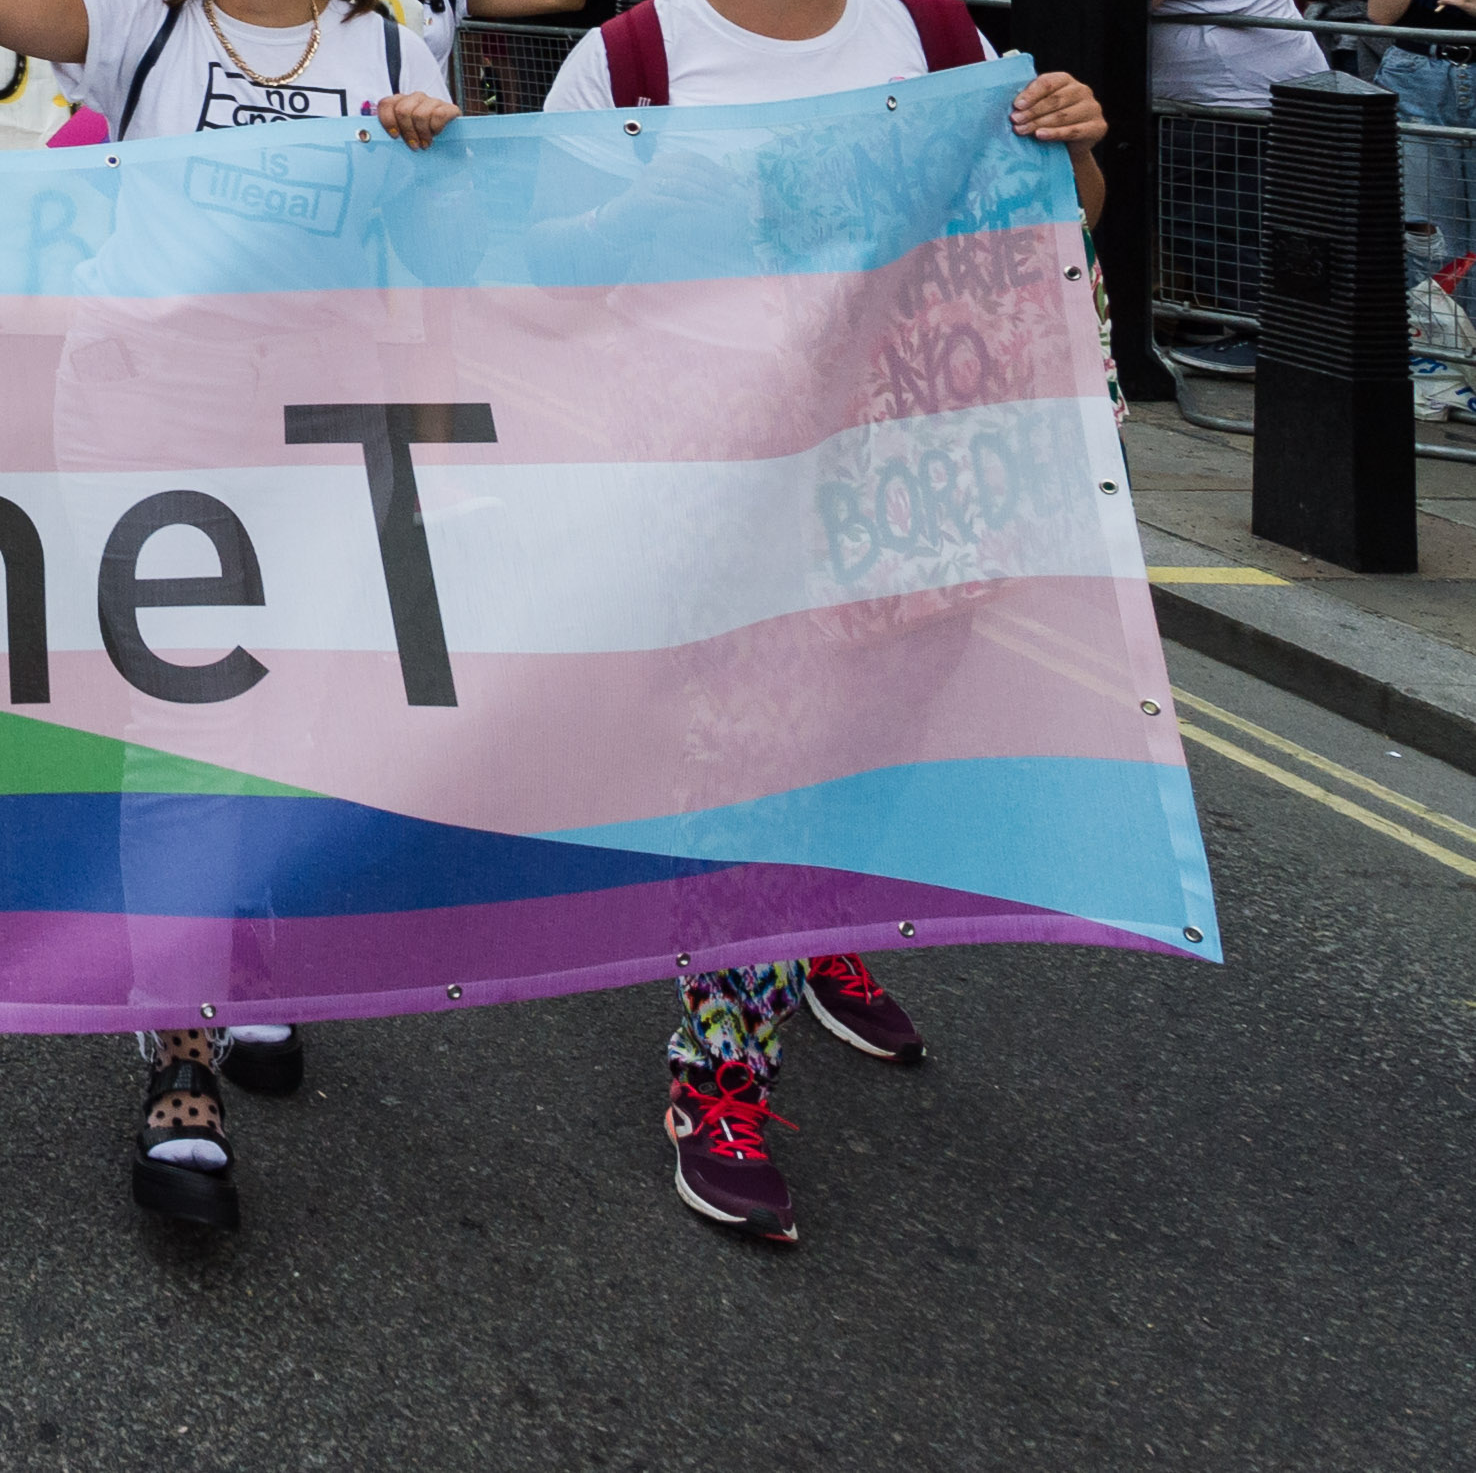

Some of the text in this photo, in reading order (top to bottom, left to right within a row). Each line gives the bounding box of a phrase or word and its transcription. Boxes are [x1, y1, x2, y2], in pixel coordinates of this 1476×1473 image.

[264, 89, 311, 114] no
[259, 146, 290, 178] is
[207, 162, 324, 221] illegal
